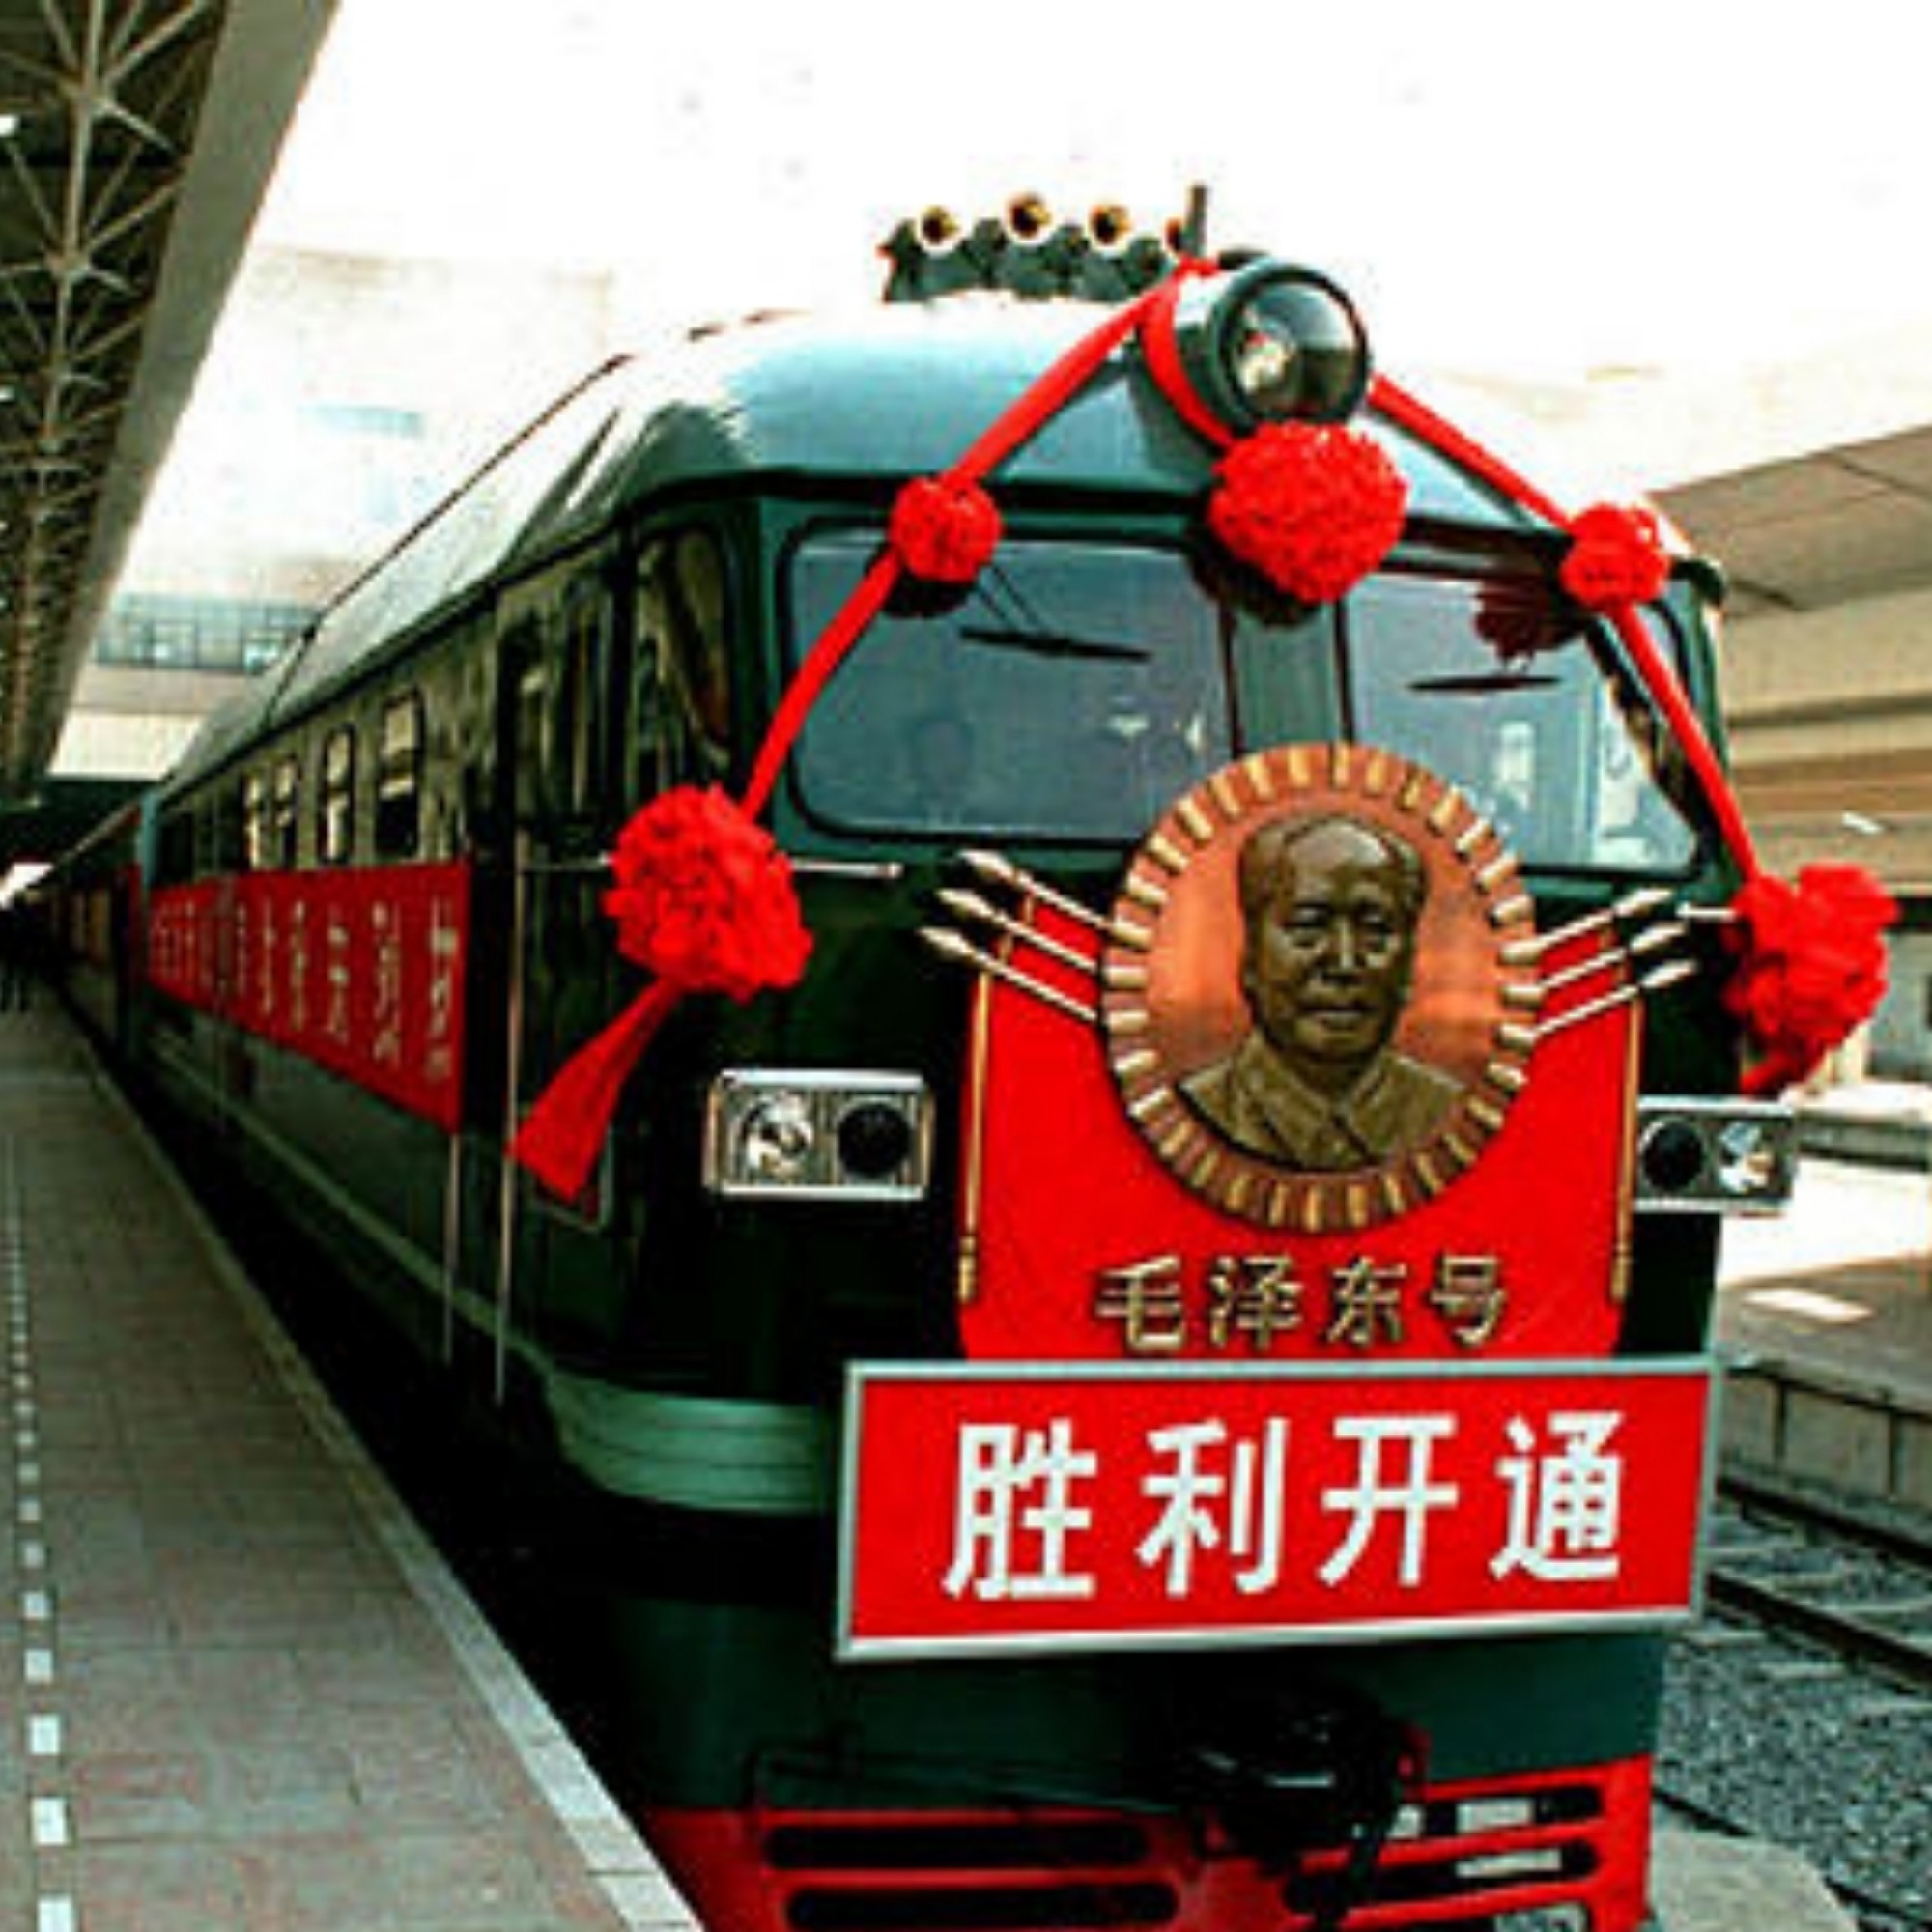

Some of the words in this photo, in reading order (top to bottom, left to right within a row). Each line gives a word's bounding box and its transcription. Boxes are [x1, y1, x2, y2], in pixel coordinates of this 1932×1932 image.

[1095, 1253, 1510, 1351] 毛泽东号
[942, 1409, 1626, 1603] 胜利开通
